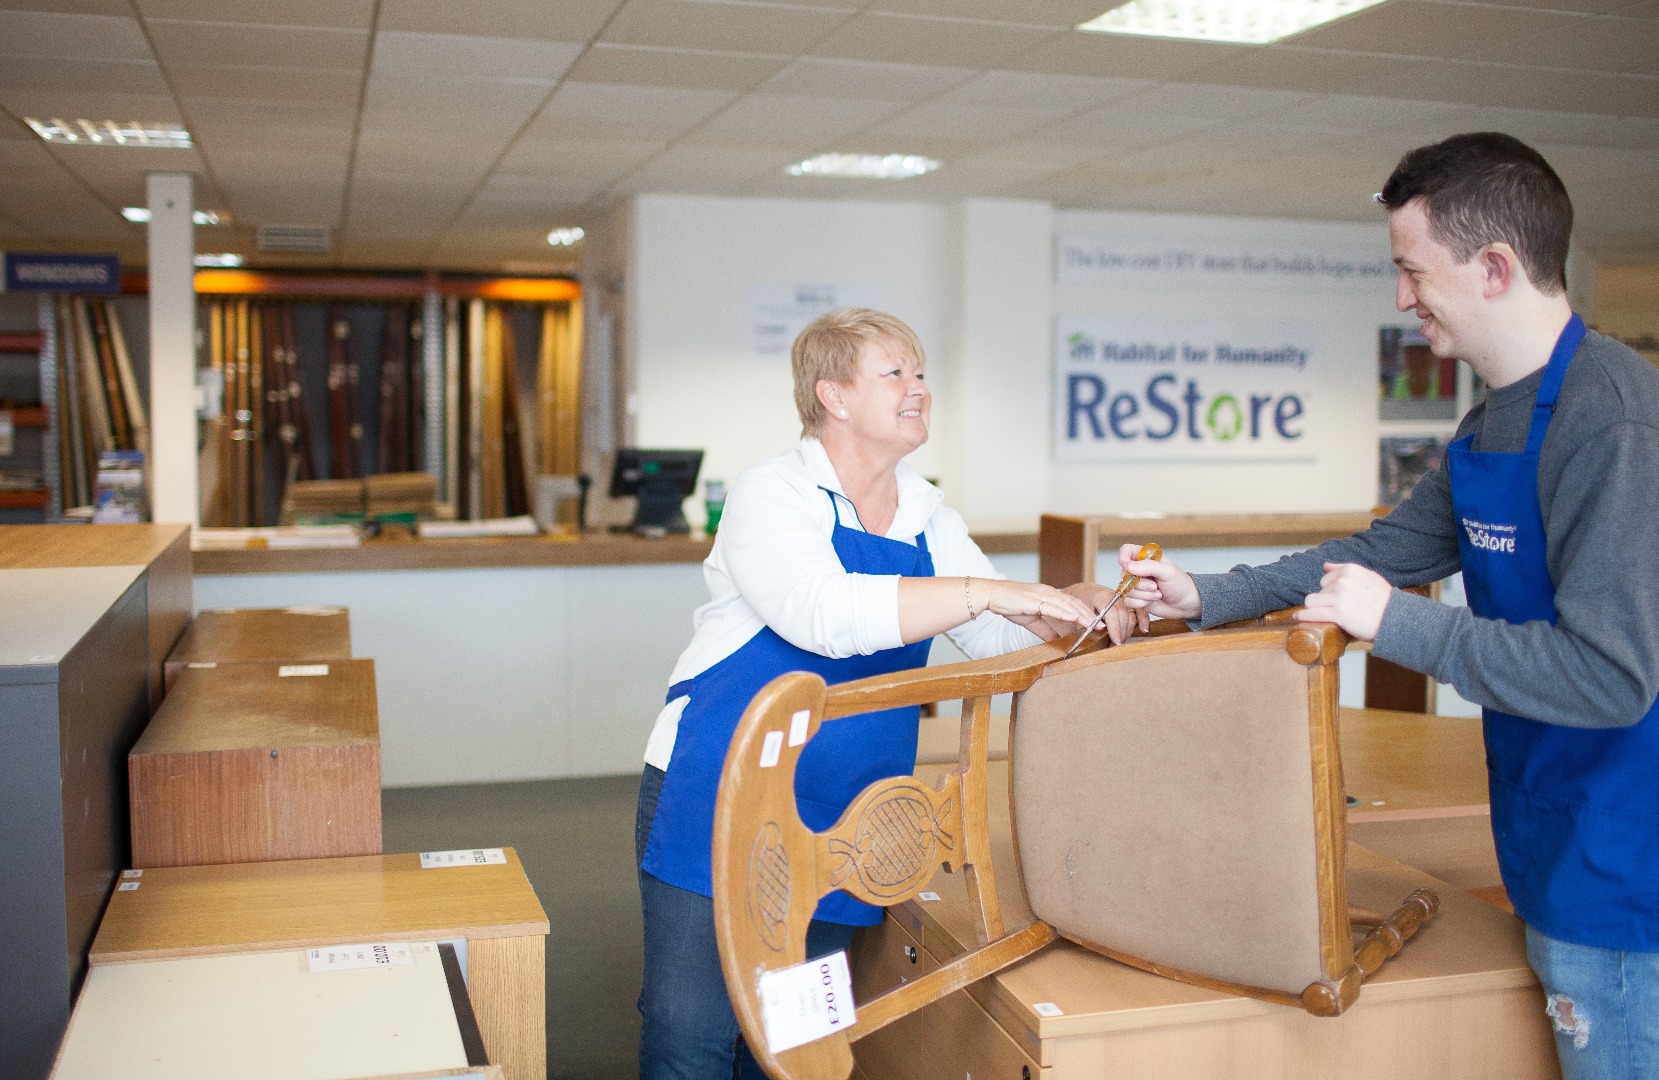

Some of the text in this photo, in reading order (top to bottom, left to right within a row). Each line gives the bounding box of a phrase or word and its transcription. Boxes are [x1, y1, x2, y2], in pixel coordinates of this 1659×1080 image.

[16, 263, 108, 284] WINDOWS
[1102, 341, 1306, 372] Habitat for Humanity
[1066, 372, 1305, 443] ReStore
[820, 963, 840, 1025] £20.00
